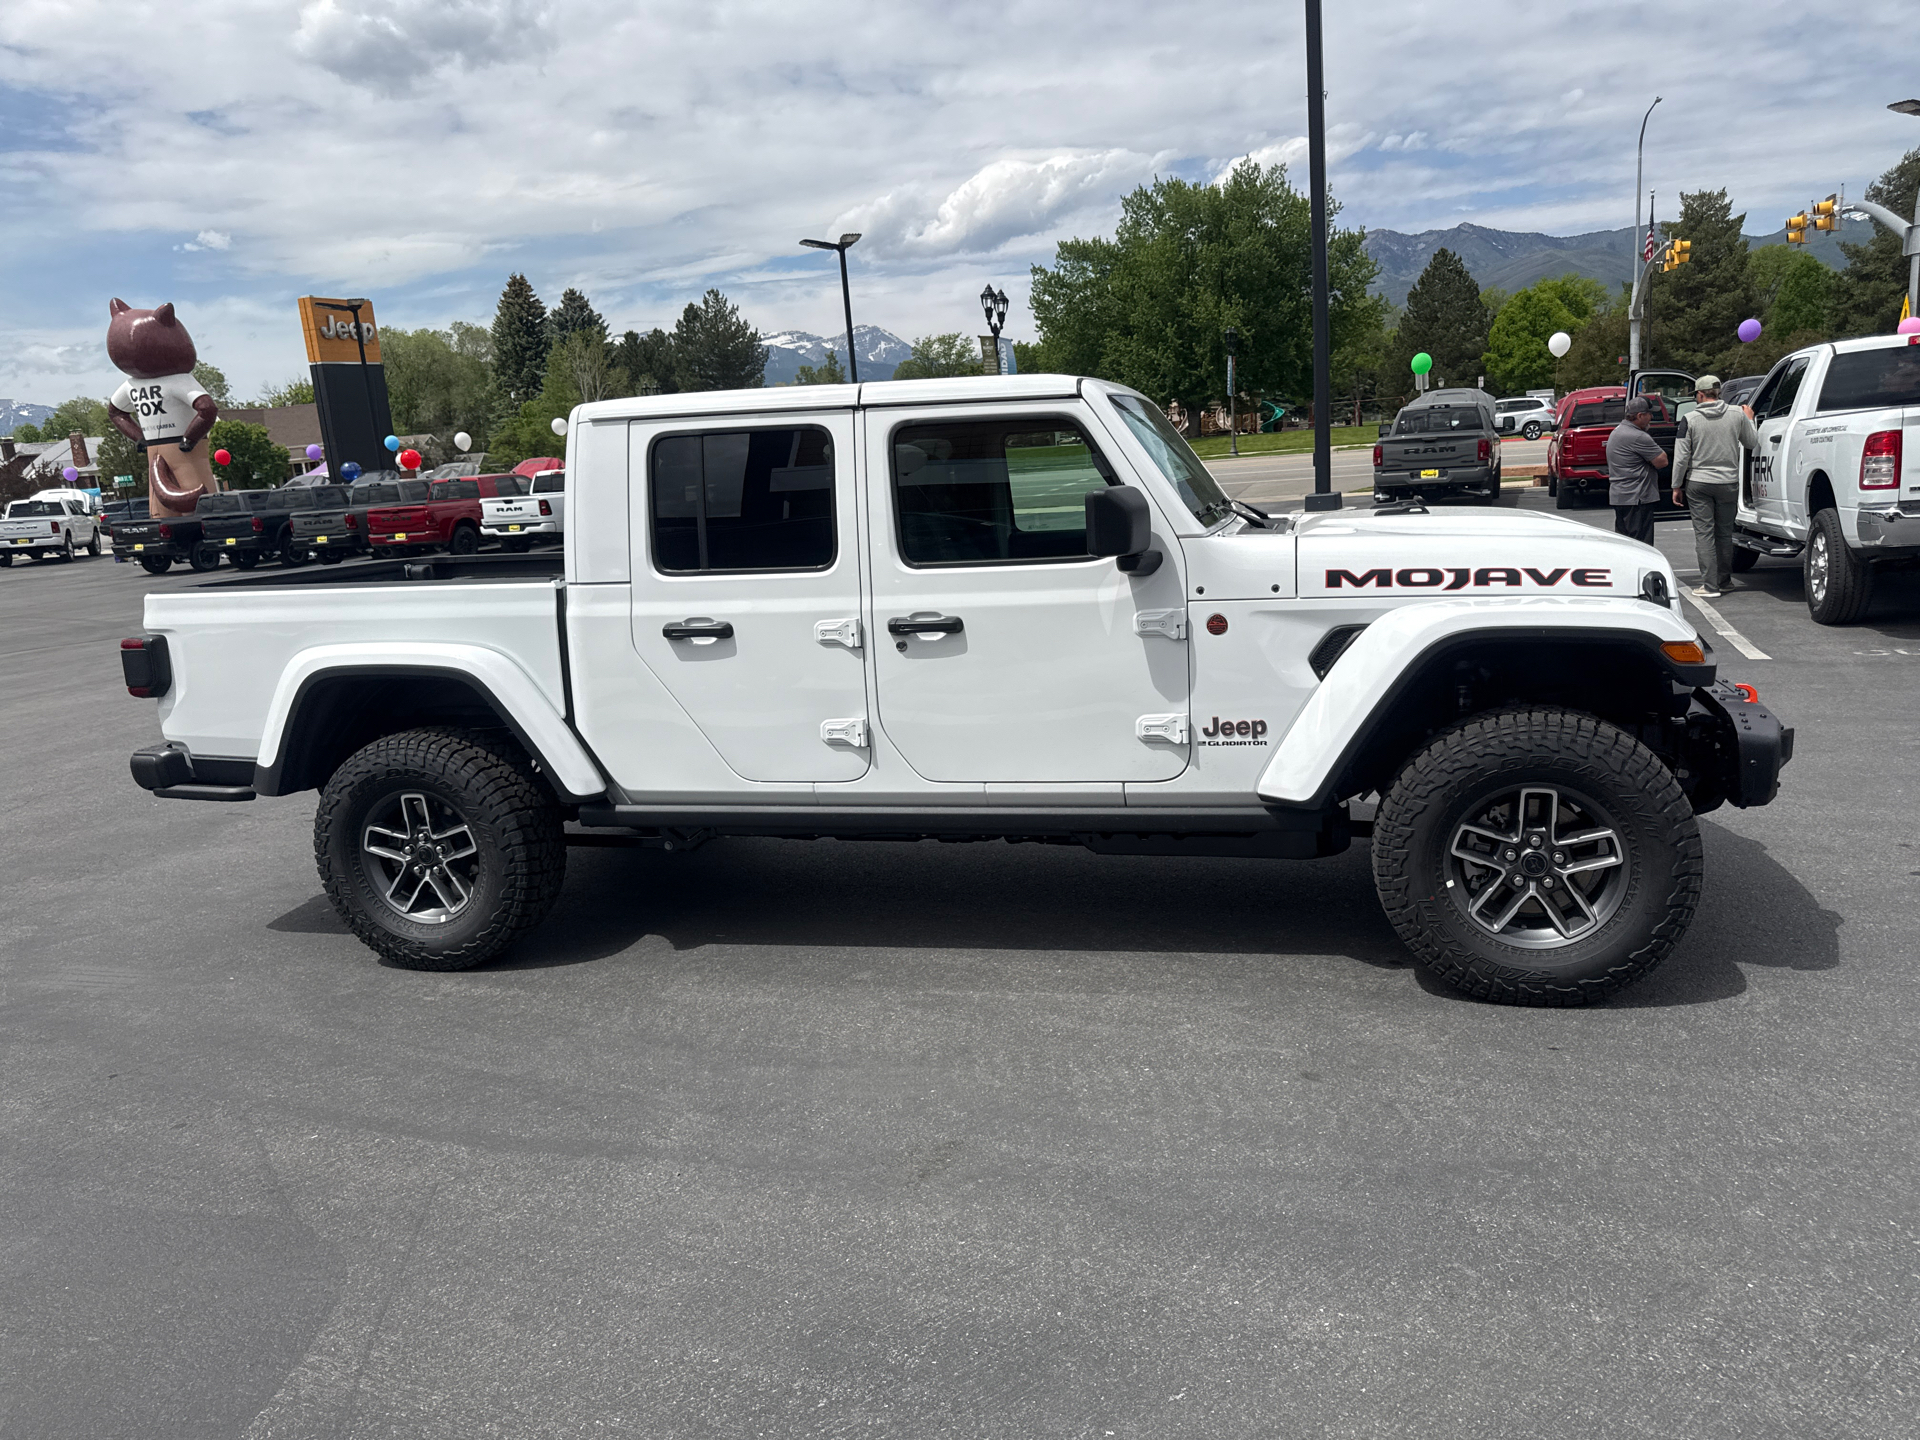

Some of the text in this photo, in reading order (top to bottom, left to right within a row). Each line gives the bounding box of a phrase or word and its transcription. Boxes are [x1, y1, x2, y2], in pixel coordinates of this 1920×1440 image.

[321, 315, 375, 345] Jeep
[130, 385, 164, 402] CAR
[133, 400, 167, 417] FOX
[1403, 446, 1456, 455] RAM
[1325, 567, 1613, 591] MOJAVE
[1202, 716, 1267, 740] Jeep
